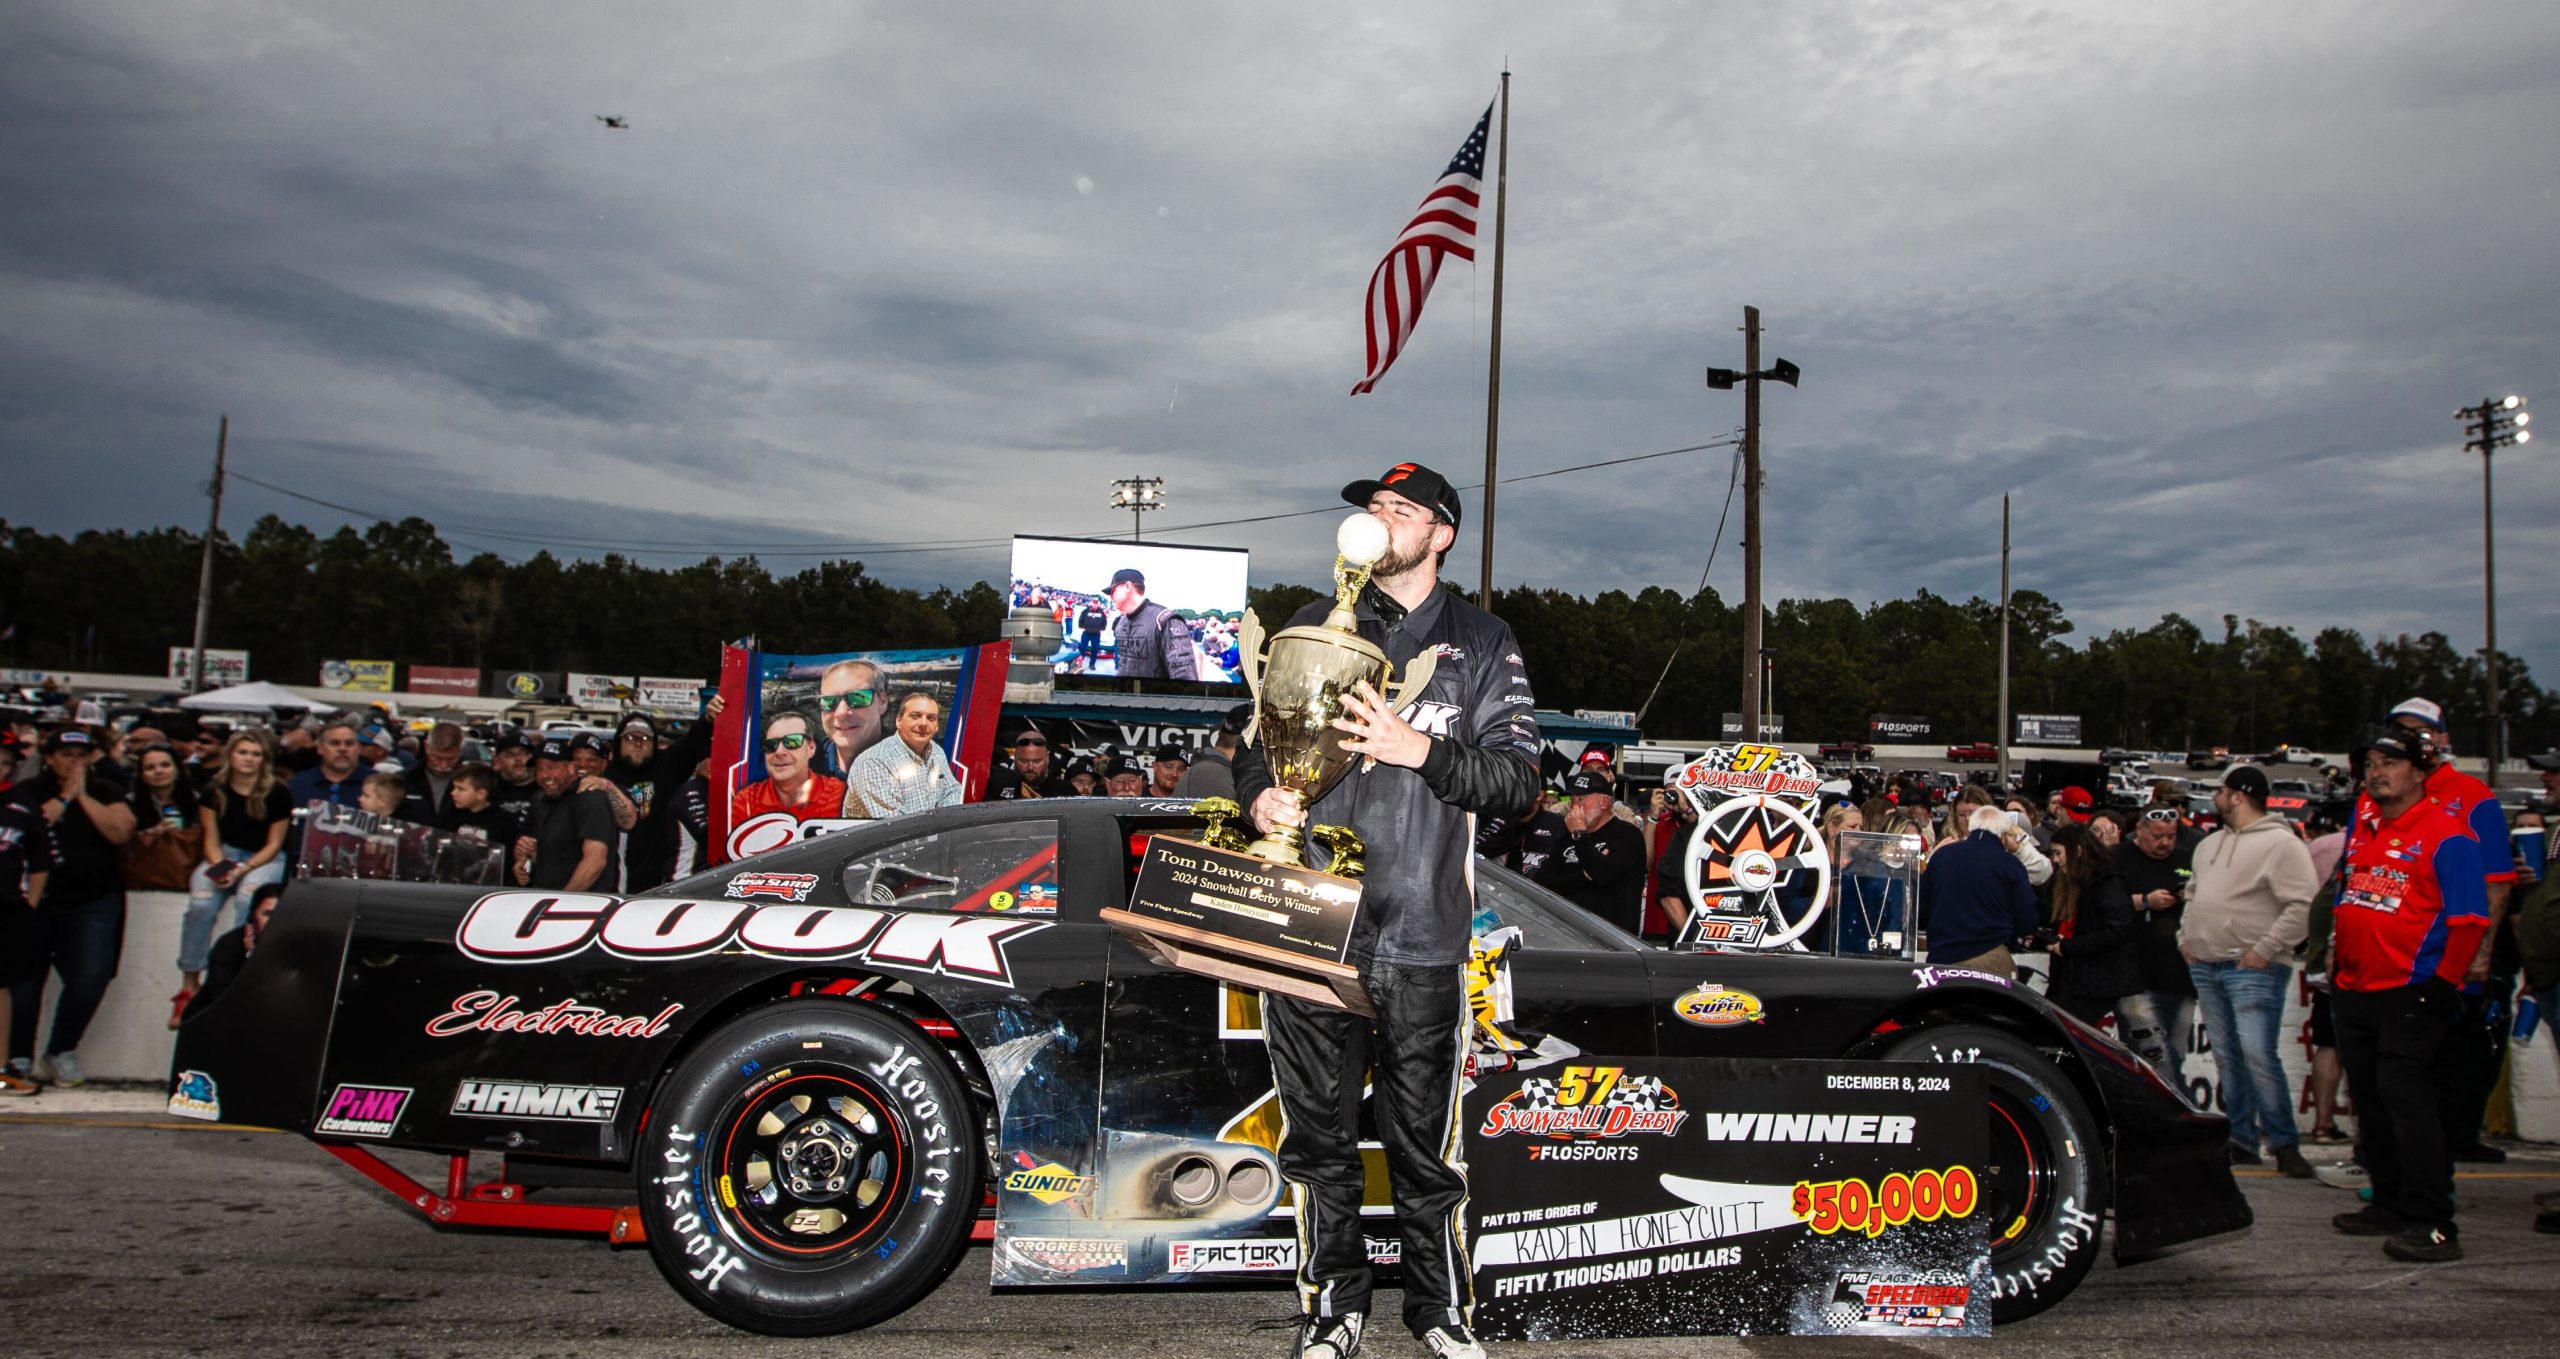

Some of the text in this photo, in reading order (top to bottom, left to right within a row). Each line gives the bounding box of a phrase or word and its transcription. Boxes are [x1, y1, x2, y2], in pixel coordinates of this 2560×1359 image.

[1722, 723, 1743, 733] SEA
[1878, 722, 1931, 734] FLOSPORTS
[1730, 745, 1779, 772] 57
[1681, 764, 1824, 797] SNOWBALL DERBY
[1158, 849, 1197, 870] Tom
[1200, 859, 1276, 889] Dawson
[765, 878, 812, 889] SLATER
[1171, 870, 1323, 916] 2024 Snowball Derby Winner
[997, 895, 1006, 903] 5
[1139, 899, 1205, 920] Five Flags Speedway
[1209, 898, 1233, 911] Kaden
[457, 891, 1058, 988] COOK
[1313, 940, 1337, 952] Florida
[1937, 968, 2009, 986] HOOSIER
[425, 990, 685, 1038] Electrical
[1686, 1002, 1744, 1015] SUPER
[1554, 1066, 1625, 1106] 57
[1827, 1075, 1951, 1093] DECEMBER 8, 2024
[459, 1082, 618, 1118] HAMKE
[321, 1117, 391, 1134] Carburetors
[868, 1045, 961, 1207] Hoosier
[1479, 1103, 1689, 1138] SNOWBALL DERBY
[1706, 1113, 1917, 1144] WINNER
[1539, 1146, 1639, 1161] FLOSPORTS
[1010, 1173, 1097, 1195] SUNOCO
[653, 1123, 748, 1291] Hoosier
[1791, 1165, 1978, 1238] $50,000
[1481, 1201, 1598, 1228] PAY TO THE ORDER OF
[1514, 1201, 1764, 1263] KADEN HONEYCUTT
[1014, 1241, 1123, 1253] PROGRESSIVE
[1193, 1242, 1294, 1266] FACTORY
[1990, 1196, 2098, 1299] Hoosier
[1494, 1246, 1742, 1298] FIFTY THOUSAND DOLLARS
[1840, 1273, 1911, 1284] FIVE FLAGS
[1865, 1284, 1971, 1306] SPEEDWAY
